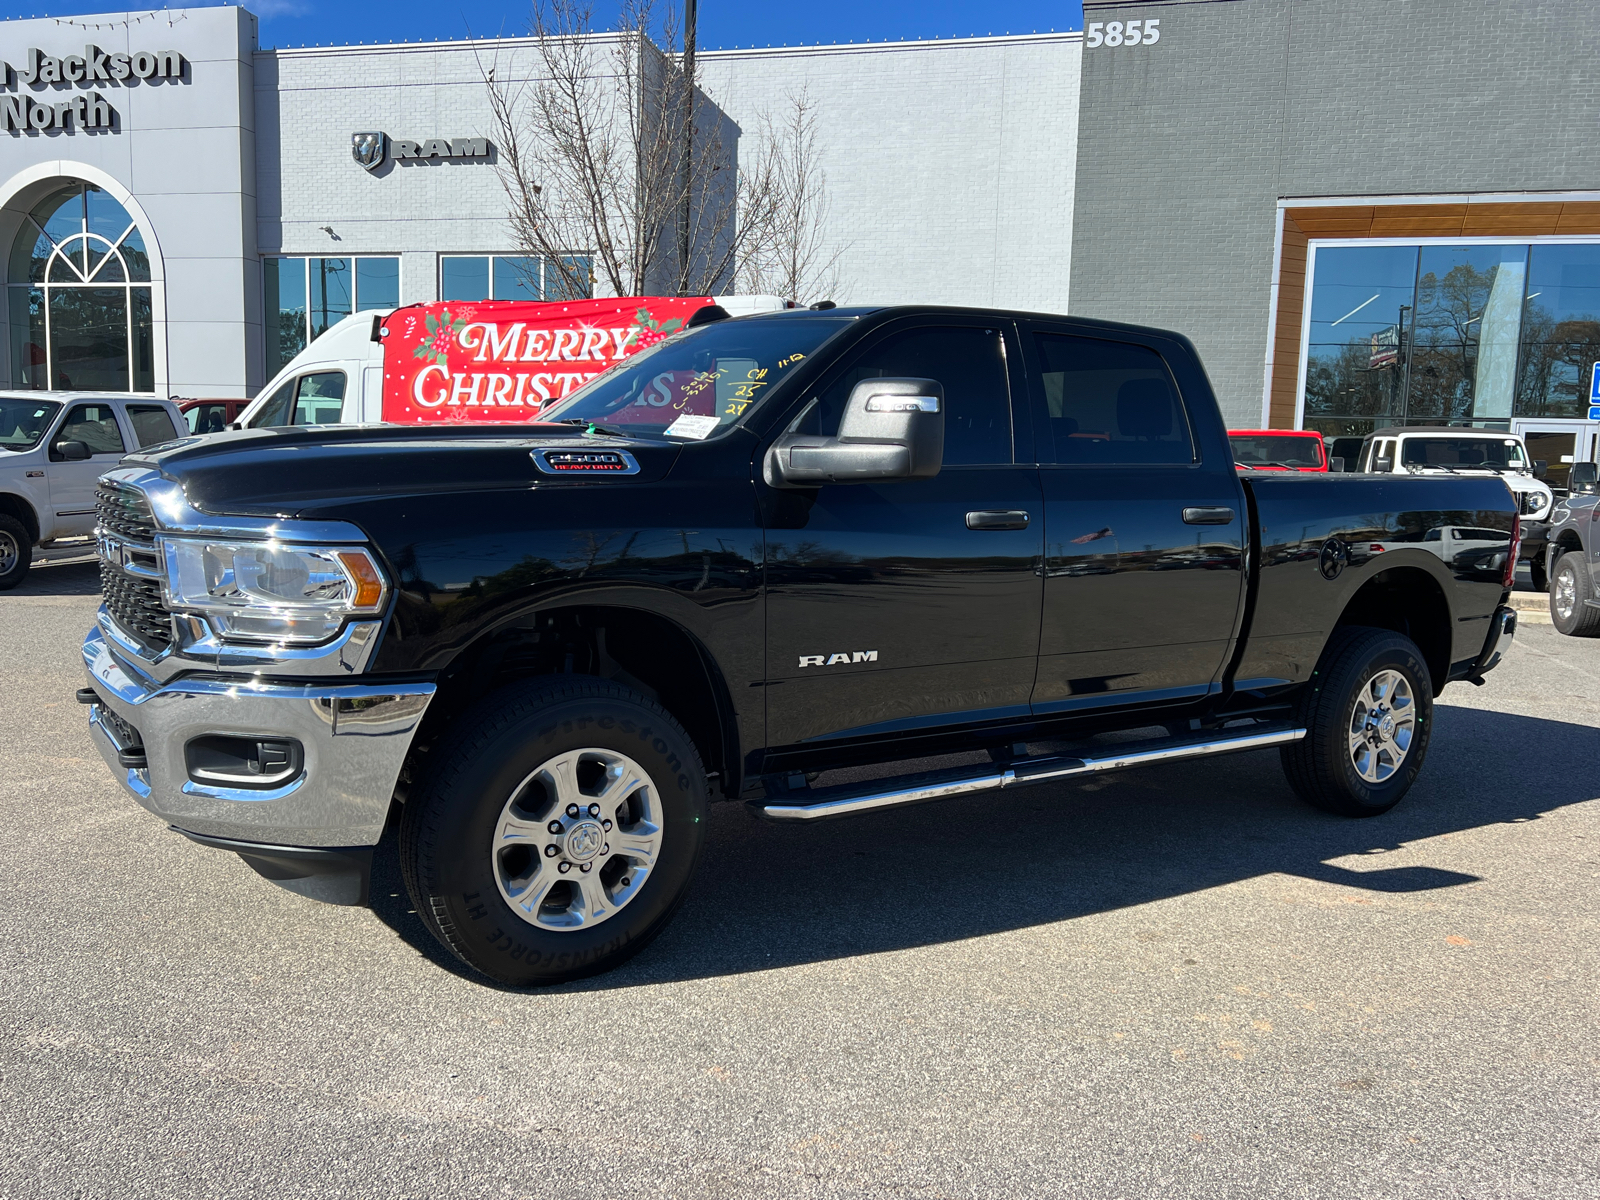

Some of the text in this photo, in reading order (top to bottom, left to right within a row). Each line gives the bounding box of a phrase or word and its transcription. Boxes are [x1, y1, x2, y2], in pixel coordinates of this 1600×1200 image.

[1086, 19, 1160, 48] 5855
[17, 44, 182, 84] Jackson
[0, 91, 111, 130] North
[390, 138, 488, 159] RAM
[458, 322, 641, 362] MERRY
[413, 364, 676, 408] CHRISTS
[550, 454, 618, 463] 2500
[798, 650, 878, 668] RAM
[537, 713, 692, 792] Firestone
[462, 892, 634, 968] TRANSFORCE HT
